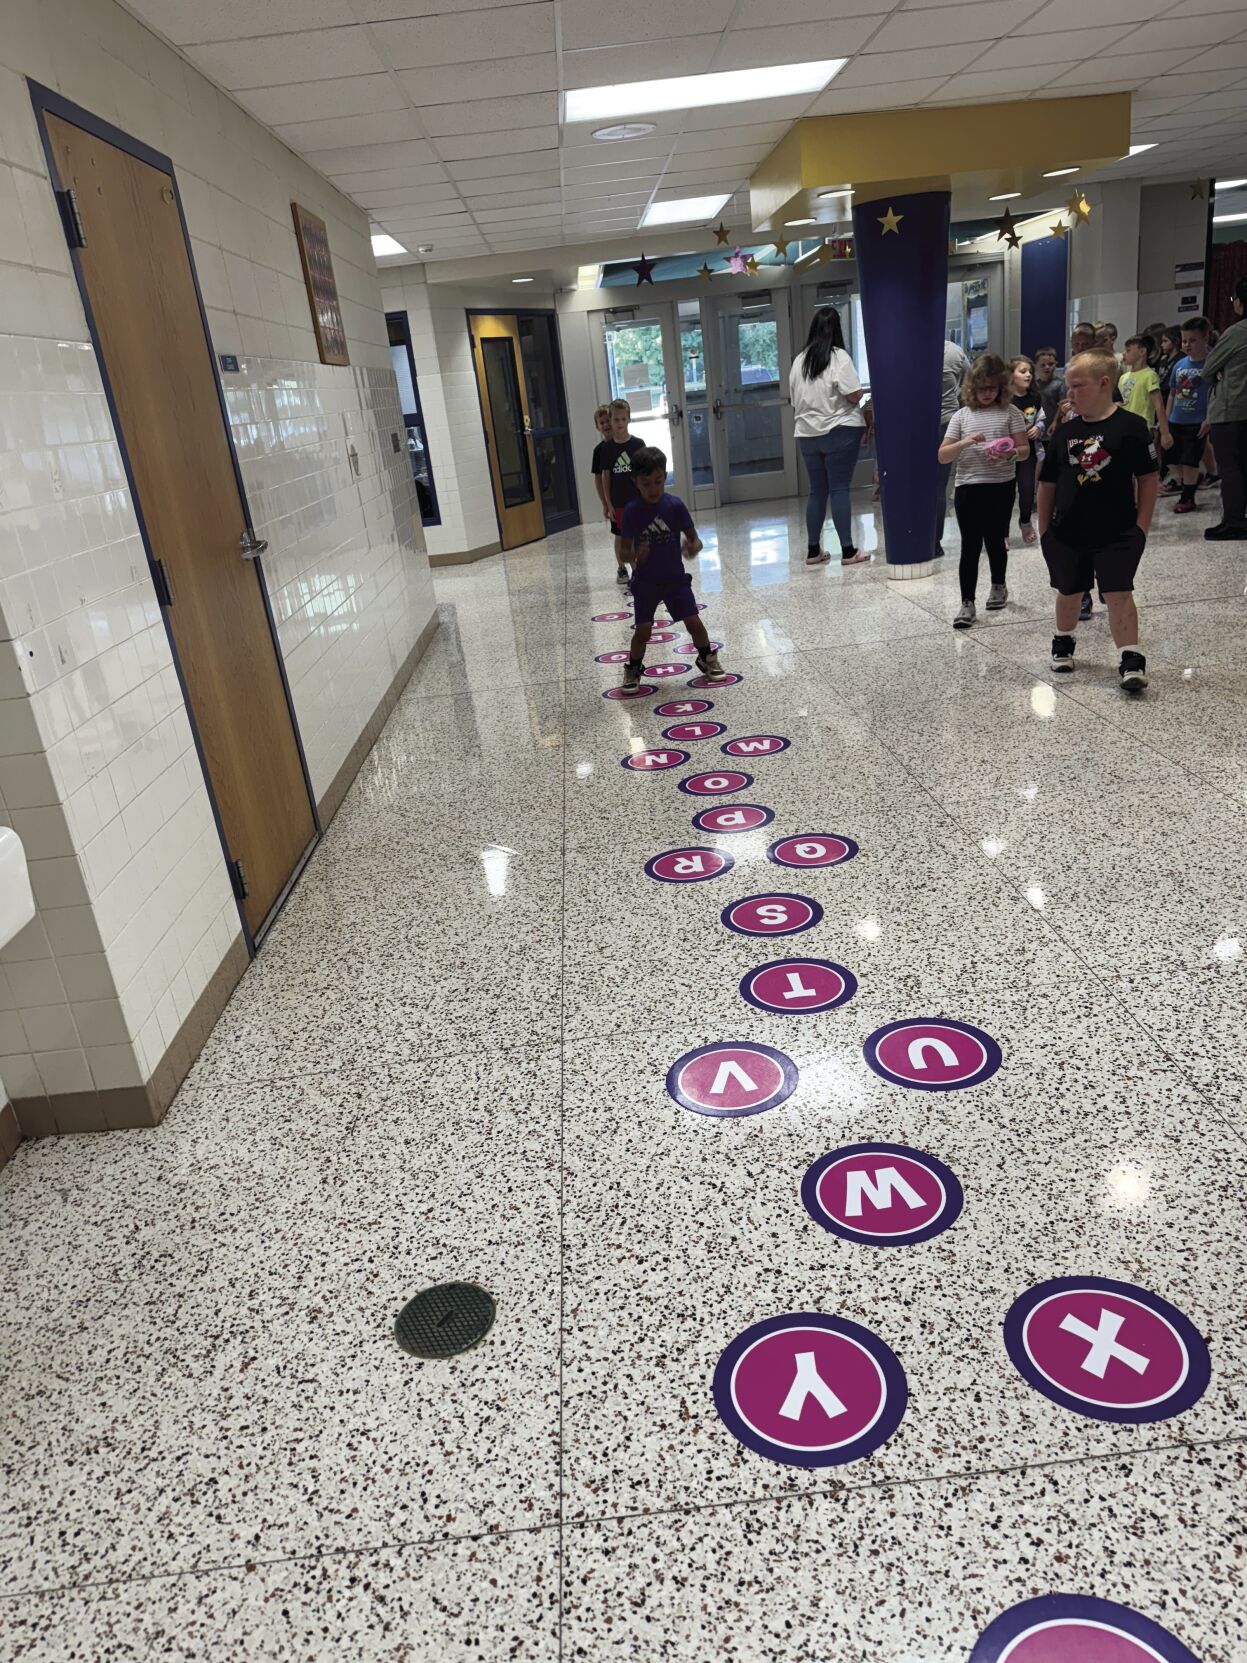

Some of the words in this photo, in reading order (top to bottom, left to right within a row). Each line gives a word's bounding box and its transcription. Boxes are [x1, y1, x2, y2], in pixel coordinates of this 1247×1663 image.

[656, 666, 675, 675] H
[674, 703, 693, 713] K
[685, 726, 703, 736] L
[737, 740, 771, 753] M
[644, 753, 669, 766] N
[704, 778, 728, 790] O
[717, 811, 746, 826] P
[795, 843, 826, 858] Q
[674, 856, 704, 873] R
[756, 905, 788, 924] S
[784, 973, 816, 1001] T
[908, 1038, 959, 1069] U
[709, 1061, 758, 1095] V
[845, 1167, 926, 1217] W
[1059, 1309, 1150, 1380] X
[779, 1352, 848, 1420] Y
